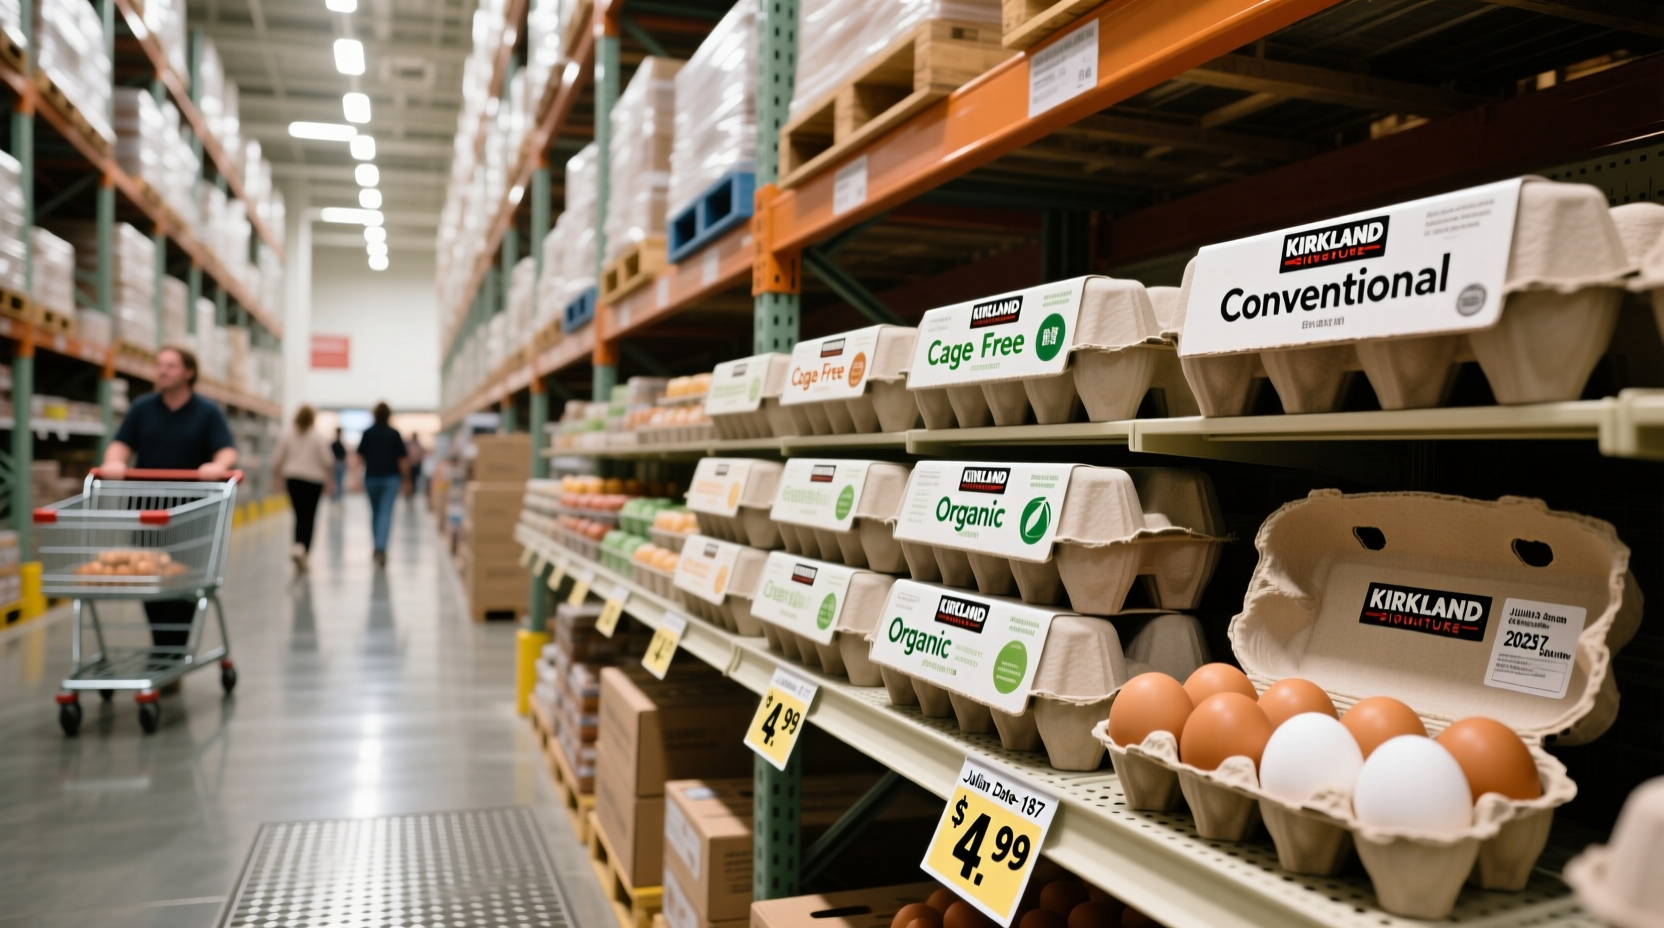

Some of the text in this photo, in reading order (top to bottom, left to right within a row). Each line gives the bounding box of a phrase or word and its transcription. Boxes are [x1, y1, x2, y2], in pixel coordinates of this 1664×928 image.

[1286, 222, 1384, 258] KIRKLAND
[1220, 252, 1450, 322] Conventional
[928, 340, 974, 370] Cage
[981, 332, 1025, 358] Free
[821, 362, 845, 382] Free
[936, 496, 1006, 532] Organic
[1369, 588, 1483, 622] KIRKLAND
[888, 617, 952, 659] Organic
[1021, 796, 1046, 818] 187
